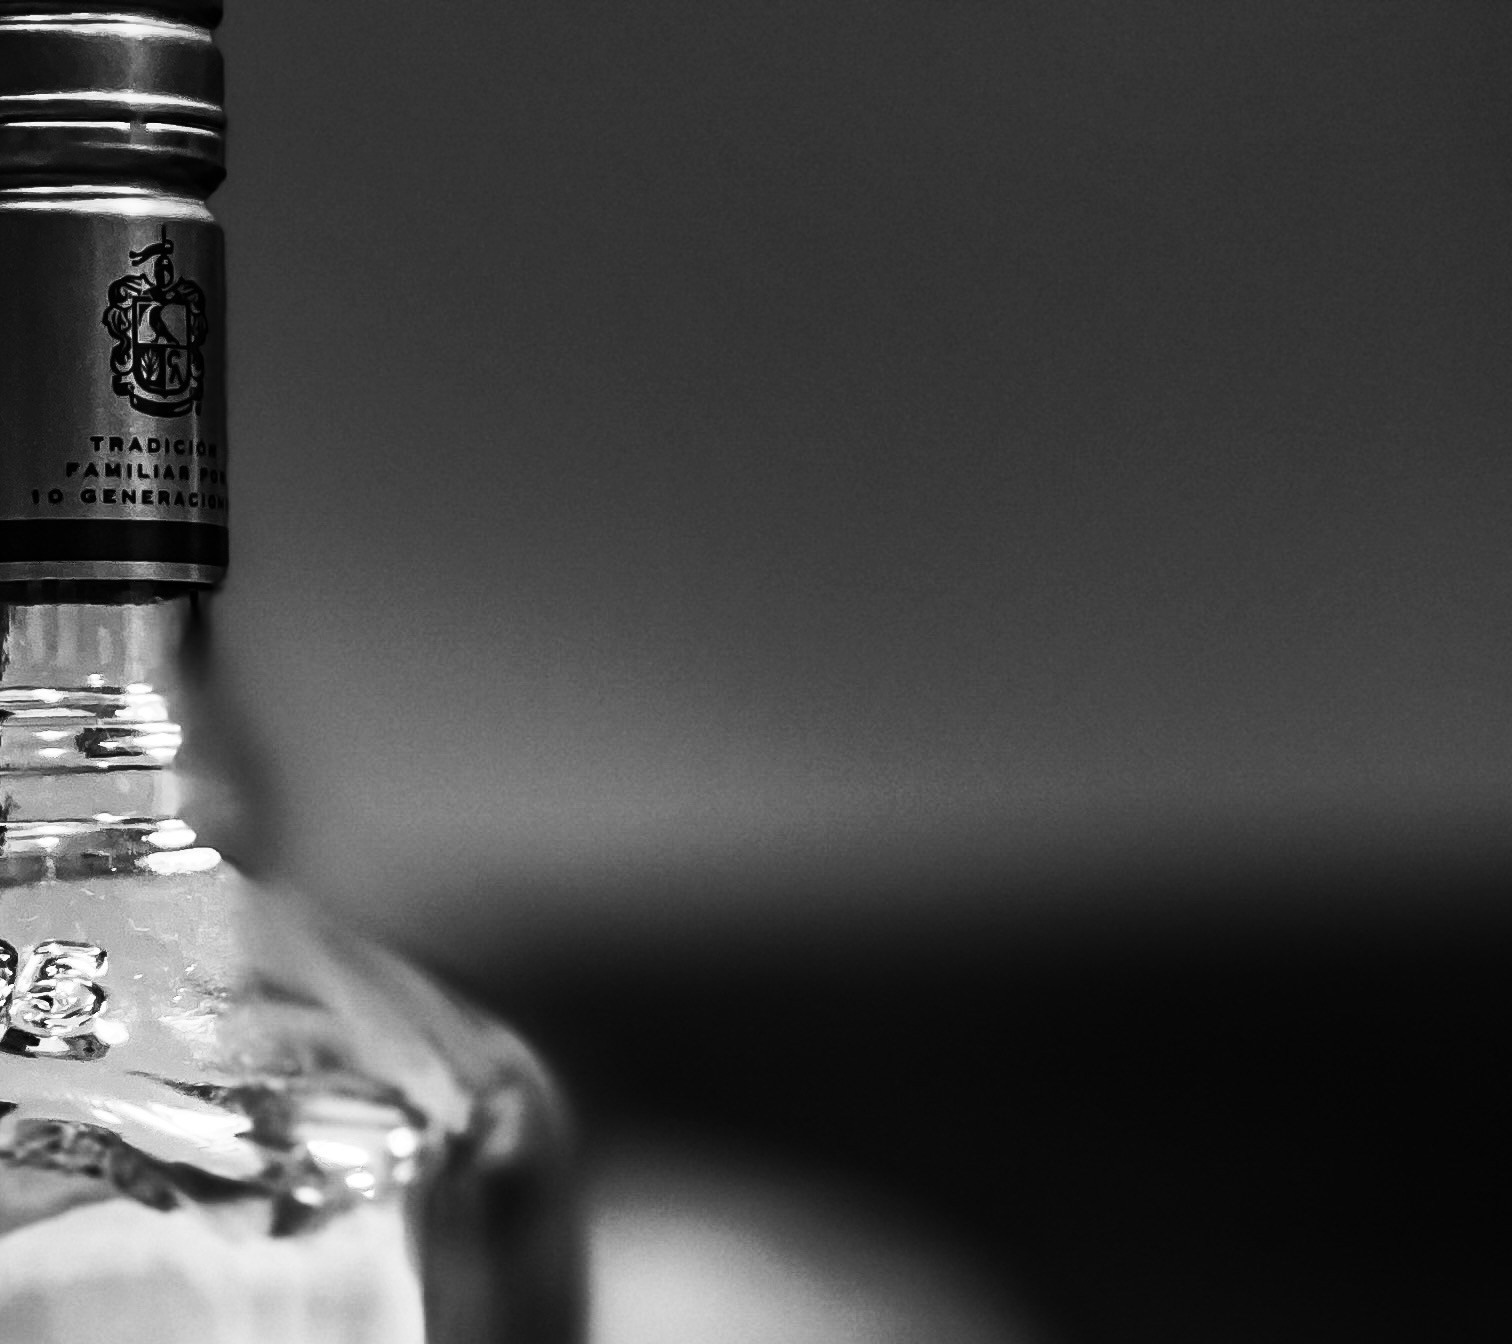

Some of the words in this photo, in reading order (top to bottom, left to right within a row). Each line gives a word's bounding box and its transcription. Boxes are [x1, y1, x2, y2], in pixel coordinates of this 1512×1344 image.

[65, 461, 190, 481] FAMILIAR
[31, 488, 64, 506] 10
[79, 488, 228, 510] GENERACION
